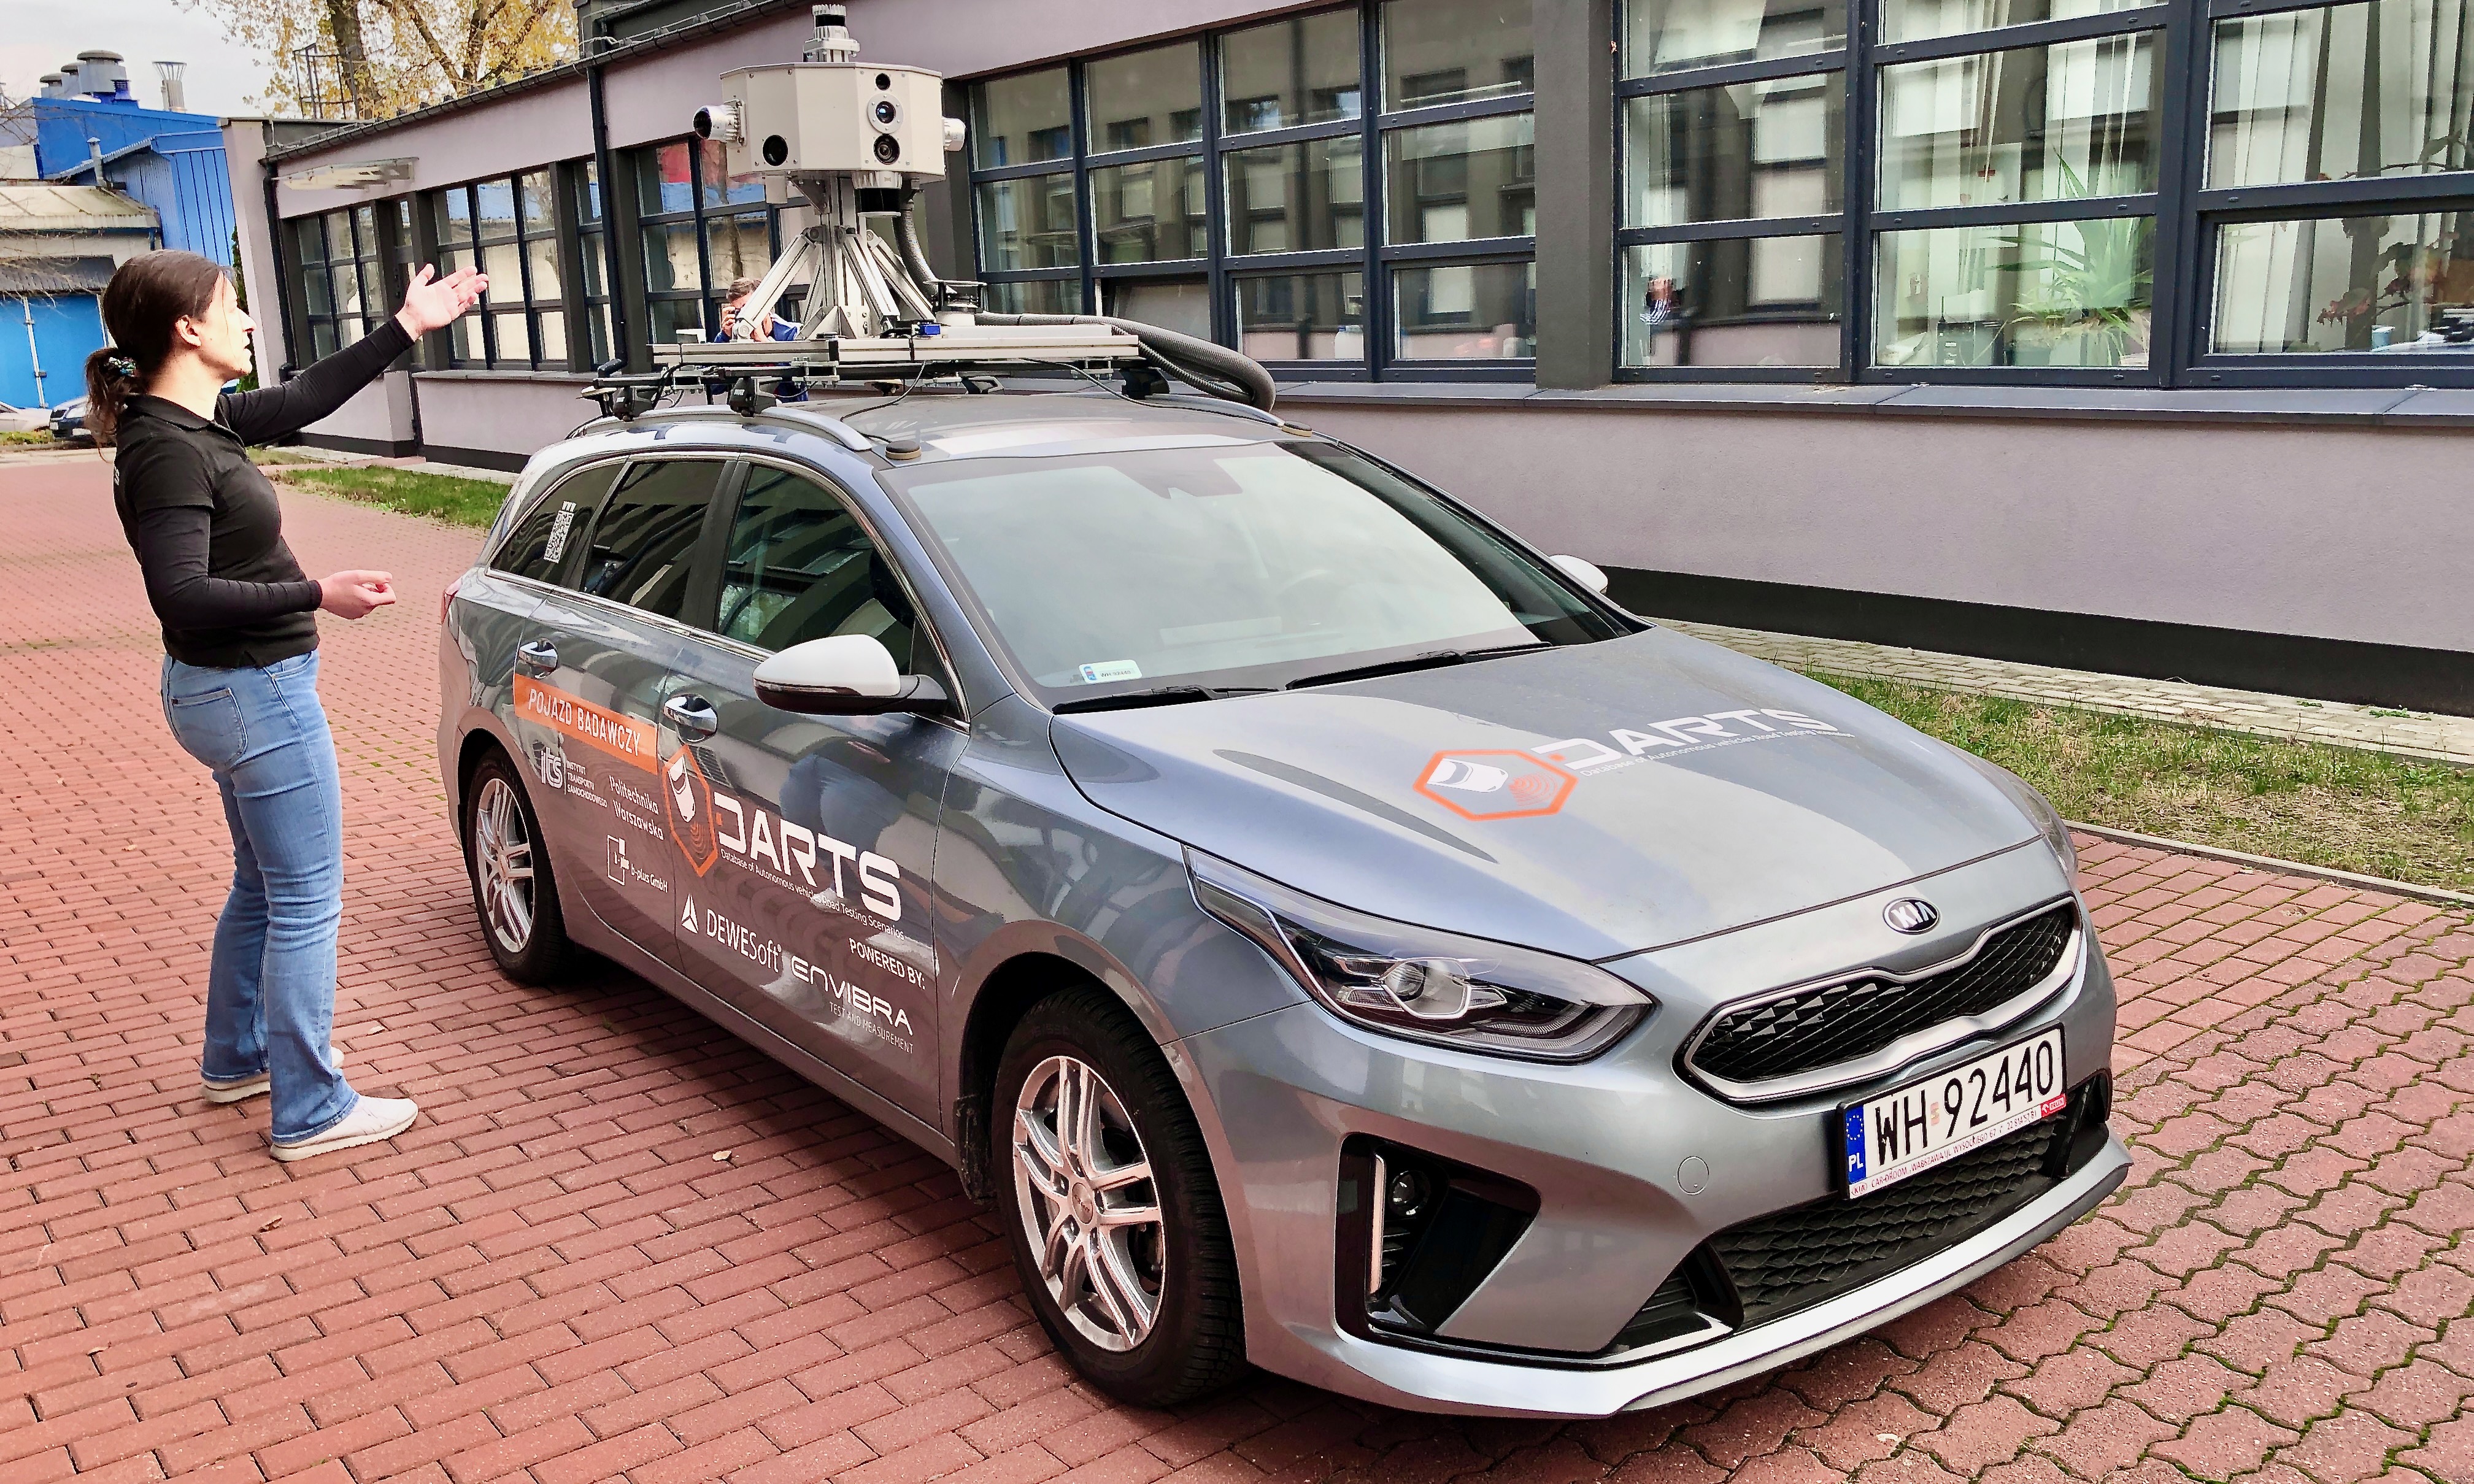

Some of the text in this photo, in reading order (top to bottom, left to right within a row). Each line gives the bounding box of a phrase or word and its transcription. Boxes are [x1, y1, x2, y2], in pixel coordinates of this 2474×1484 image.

[528, 688, 641, 756] POJAZD BADAWCZY
[1530, 709, 1838, 770] DARTS
[1579, 759, 1635, 777] Database
[1647, 744, 1716, 761] Autonomous
[609, 775, 659, 815] Politechnika
[612, 799, 664, 840] Warszawska
[630, 863, 668, 893] b-plus GmbH
[714, 791, 901, 921] DARTS
[720, 848, 904, 940] Database of Autonomous vehicles Road Testing Scenarios
[1890, 901, 1936, 928] KIA
[849, 937, 925, 990] POWERED BY:
[829, 1001, 914, 1053] TEST AND MEASUREMENT
[1875, 1040, 2054, 1166] WH 92440
[1848, 1152, 1864, 1172] PL
